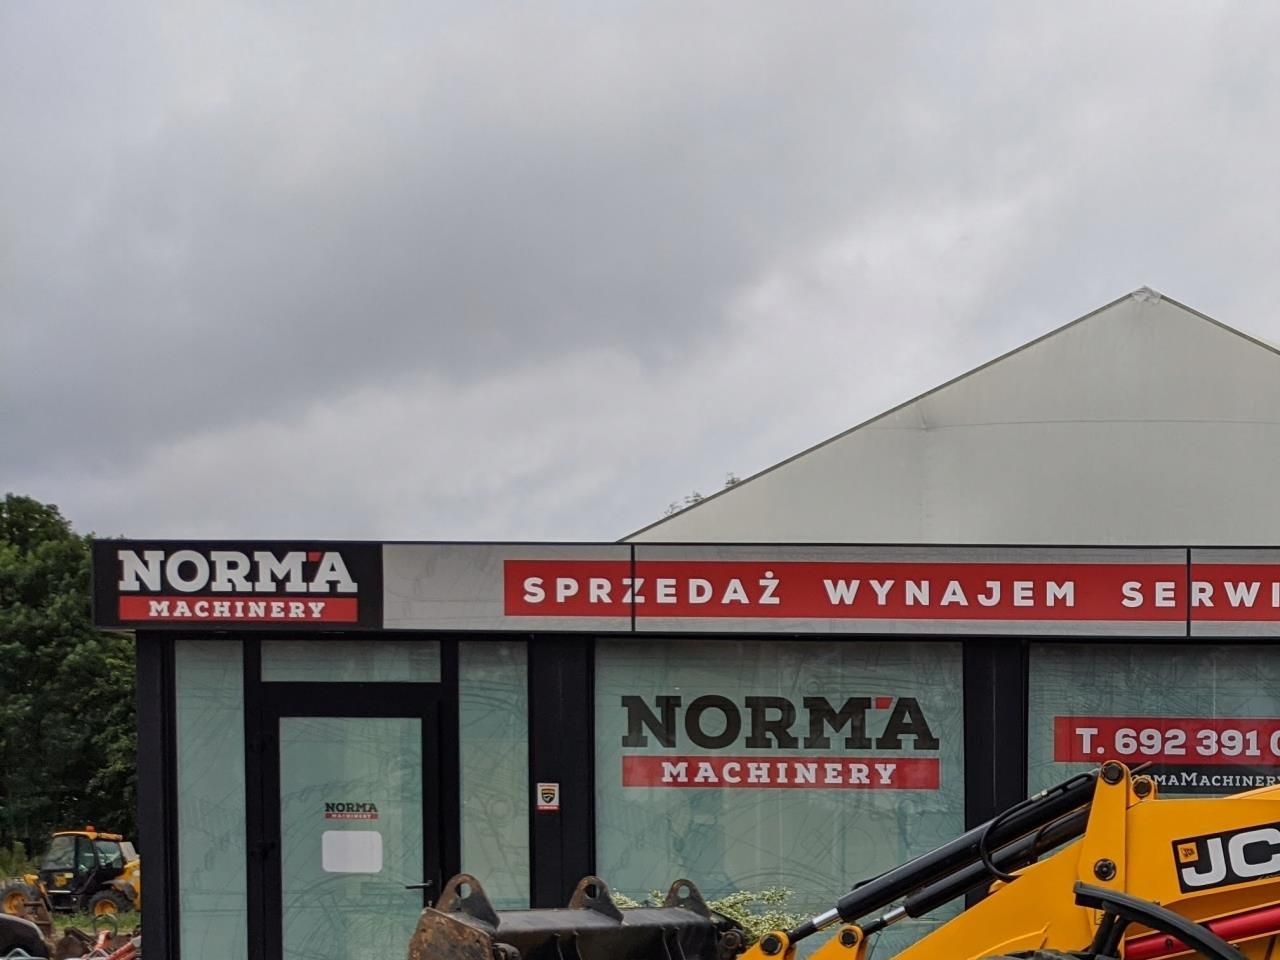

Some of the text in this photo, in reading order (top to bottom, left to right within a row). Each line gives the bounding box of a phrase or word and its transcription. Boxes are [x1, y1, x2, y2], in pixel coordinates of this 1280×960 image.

[523, 571, 780, 605] SPRZEDAŻ
[823, 580, 1075, 607] WYNAJEM
[149, 600, 326, 618] MACHINERY
[1076, 727, 1105, 754] T.
[1114, 728, 1186, 755] 692
[1196, 729, 1260, 756] 391
[661, 761, 897, 785] MACHINERY
